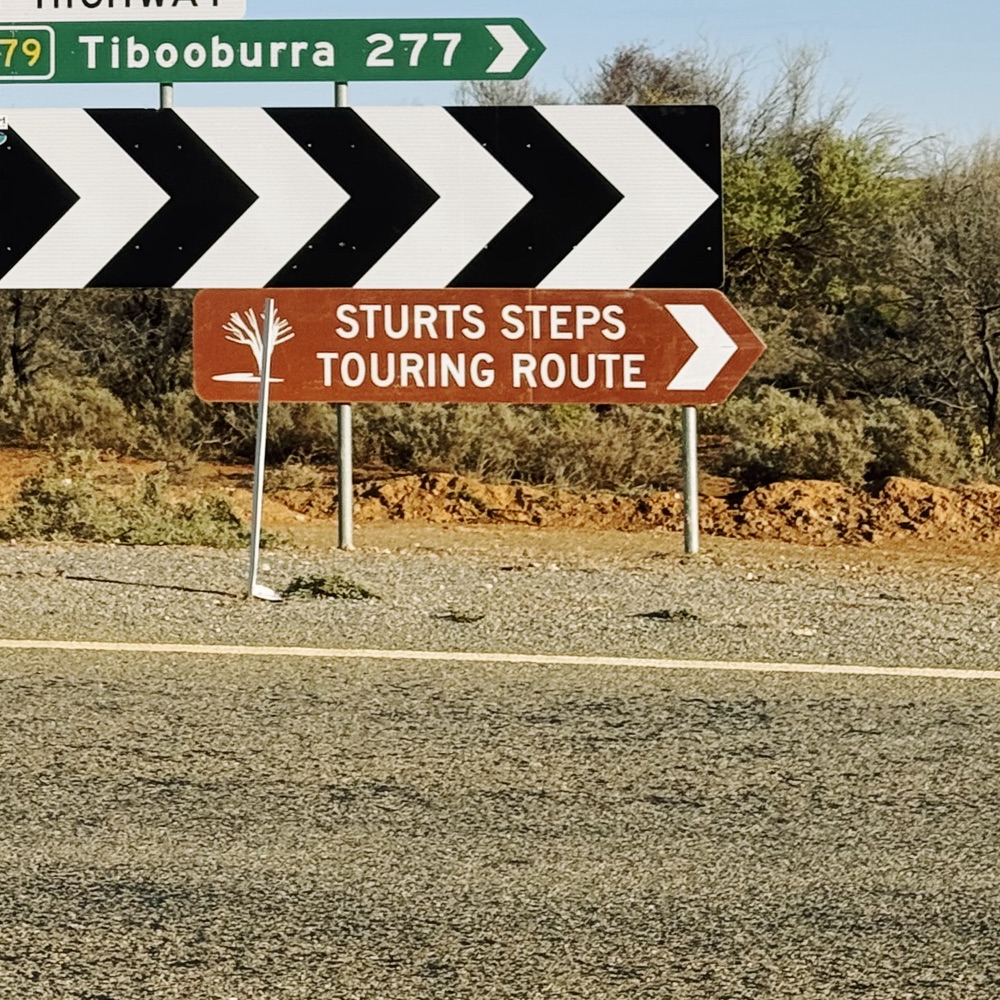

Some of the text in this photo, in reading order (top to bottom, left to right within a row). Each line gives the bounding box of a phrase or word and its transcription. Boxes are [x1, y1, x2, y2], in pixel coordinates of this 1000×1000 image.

[78, 32, 462, 69] Tibooburra 277
[335, 304, 626, 340] STURTS STEPS
[316, 352, 647, 389] TOURING ROUTE
